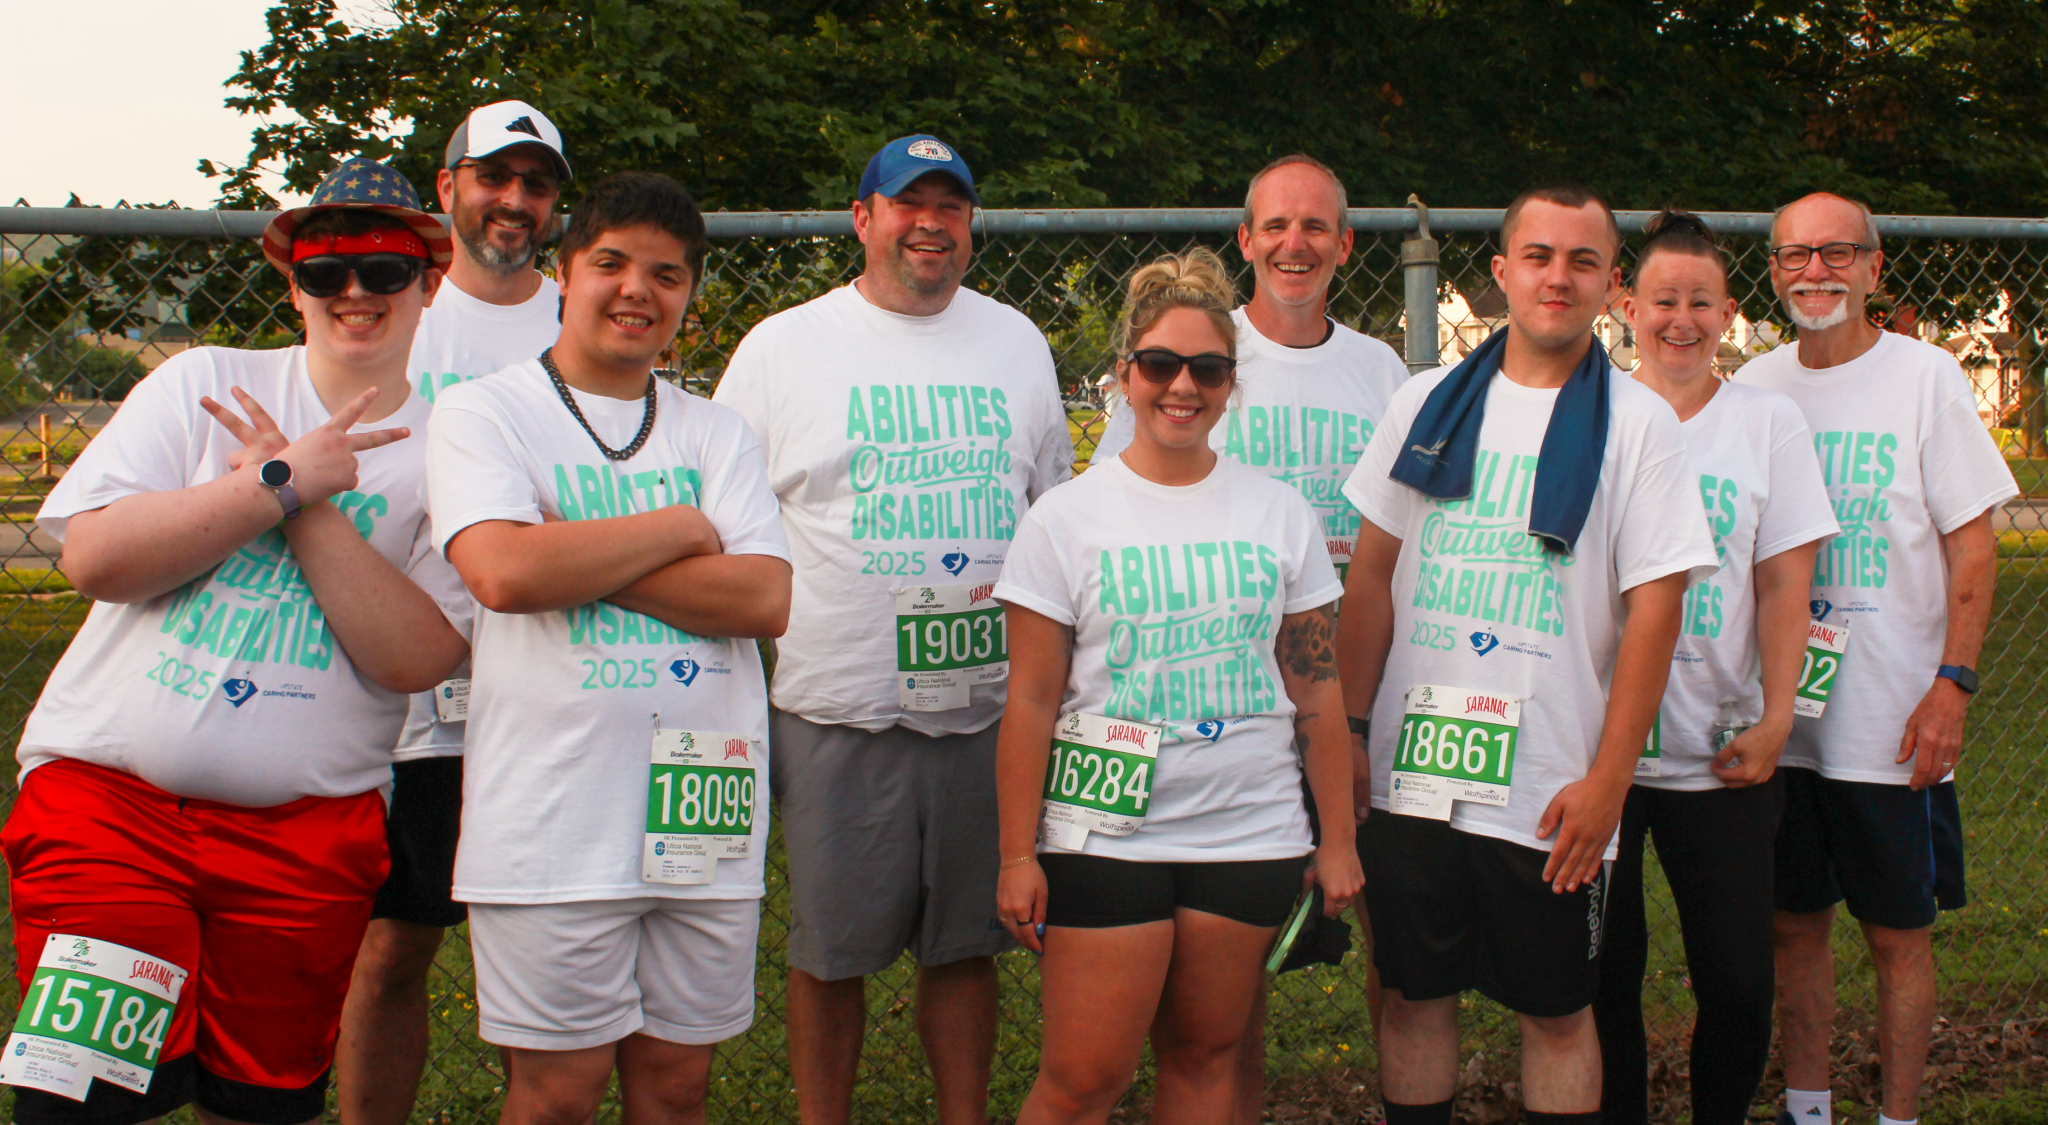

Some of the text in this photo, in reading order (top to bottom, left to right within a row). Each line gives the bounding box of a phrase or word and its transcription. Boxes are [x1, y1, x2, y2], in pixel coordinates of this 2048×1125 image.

[925, 147, 938, 155] 76
[847, 385, 1012, 444] ABILITIES
[850, 438, 1013, 493] Outweigh
[851, 487, 1017, 541] DISABILITIES
[861, 551, 926, 576] 2025
[1099, 541, 1278, 615] ABILITIES
[969, 584, 996, 606] SARAN
[1412, 561, 1564, 637] DISABILITIES
[902, 612, 1007, 665] 19031
[1105, 600, 1273, 669] Outweigh
[1409, 620, 1457, 651] 2025
[1809, 624, 1838, 647] RANAC
[1503, 645, 1552, 660] CARING PARTNERS
[146, 651, 216, 701] 2025
[582, 658, 658, 690] 2025
[1104, 655, 1276, 721] DISABILITIES
[263, 690, 316, 700] CARING PARTNERS
[1465, 696, 1508, 719] SARANAC
[724, 738, 749, 762] SARANAC
[1105, 724, 1148, 750] SARANAC
[1401, 720, 1510, 778] 18661
[670, 750, 703, 759] Boilermaker
[1050, 746, 1149, 810] 16284
[1446, 779, 1467, 787] Powered
[655, 772, 755, 827] 18099
[1464, 789, 1500, 801] Wolfspeed
[1084, 808, 1103, 818] Powered
[1099, 820, 1136, 832] Wolfspeed
[1587, 876, 1602, 961] Reebok
[129, 959, 175, 993] SARANAC
[29, 975, 170, 1061] 15184
[26, 1050, 57, 1062] Insurance
[28, 1044, 73, 1059] Utica National
[106, 1067, 141, 1086] Wolfspeed
